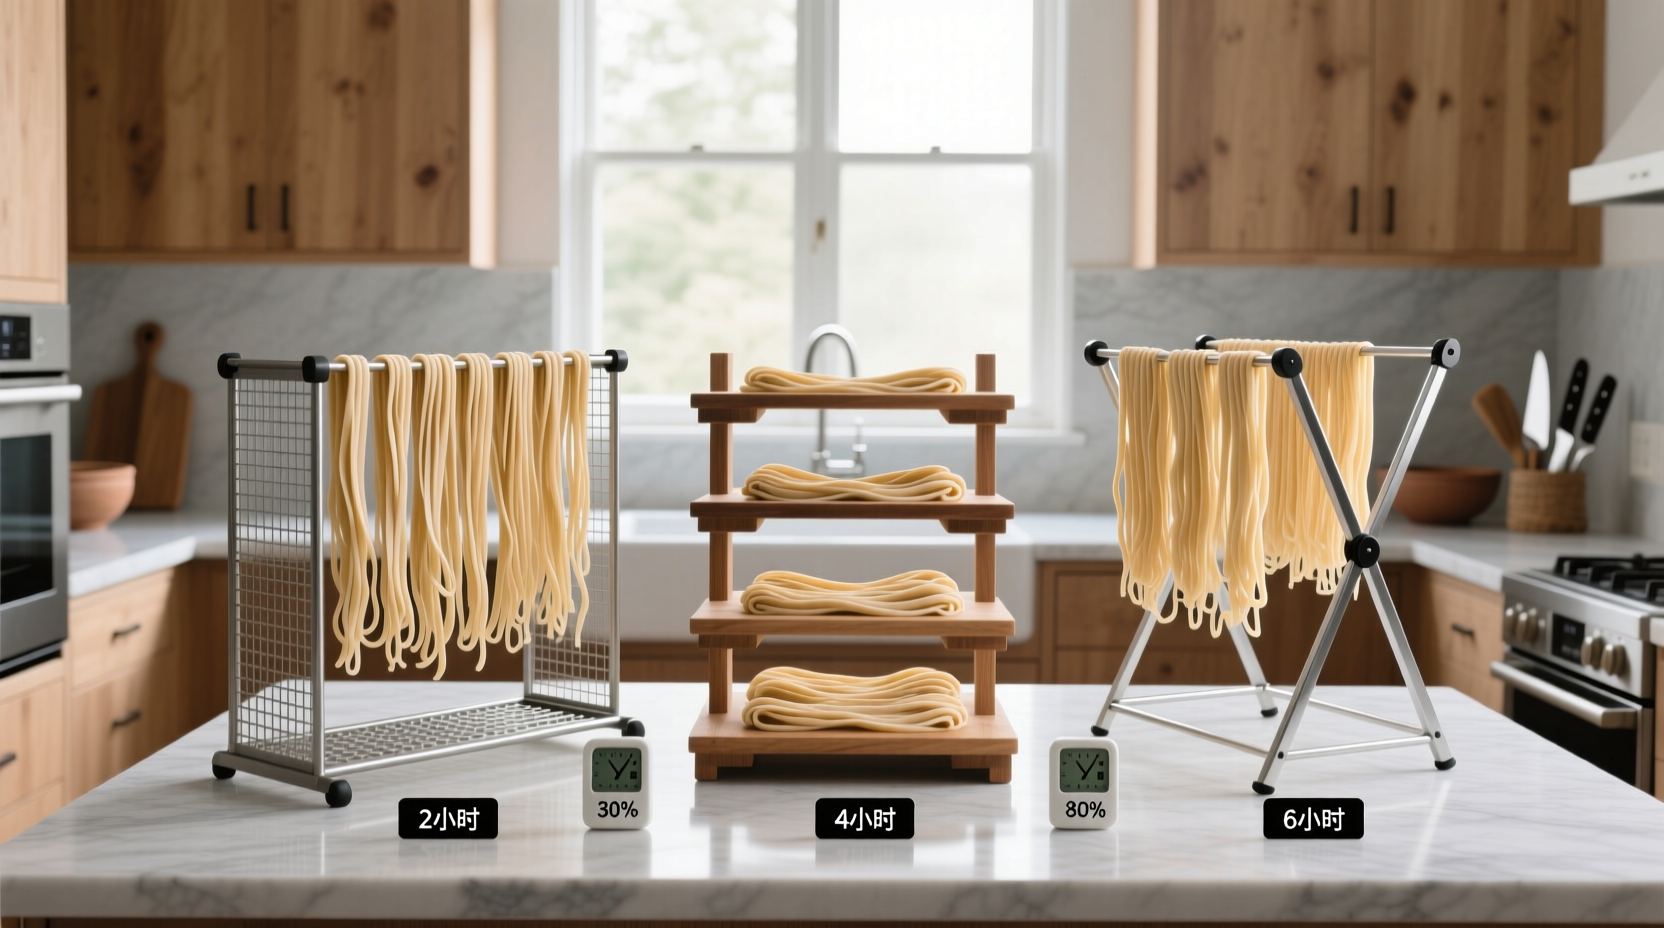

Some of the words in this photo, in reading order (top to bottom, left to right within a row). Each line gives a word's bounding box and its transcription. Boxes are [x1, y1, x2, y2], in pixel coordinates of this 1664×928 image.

[418, 807, 480, 831] 2小时
[597, 800, 639, 818] 30%
[834, 807, 896, 831] 4小时
[1065, 800, 1107, 819] 80%
[1283, 807, 1345, 831] 6小时
